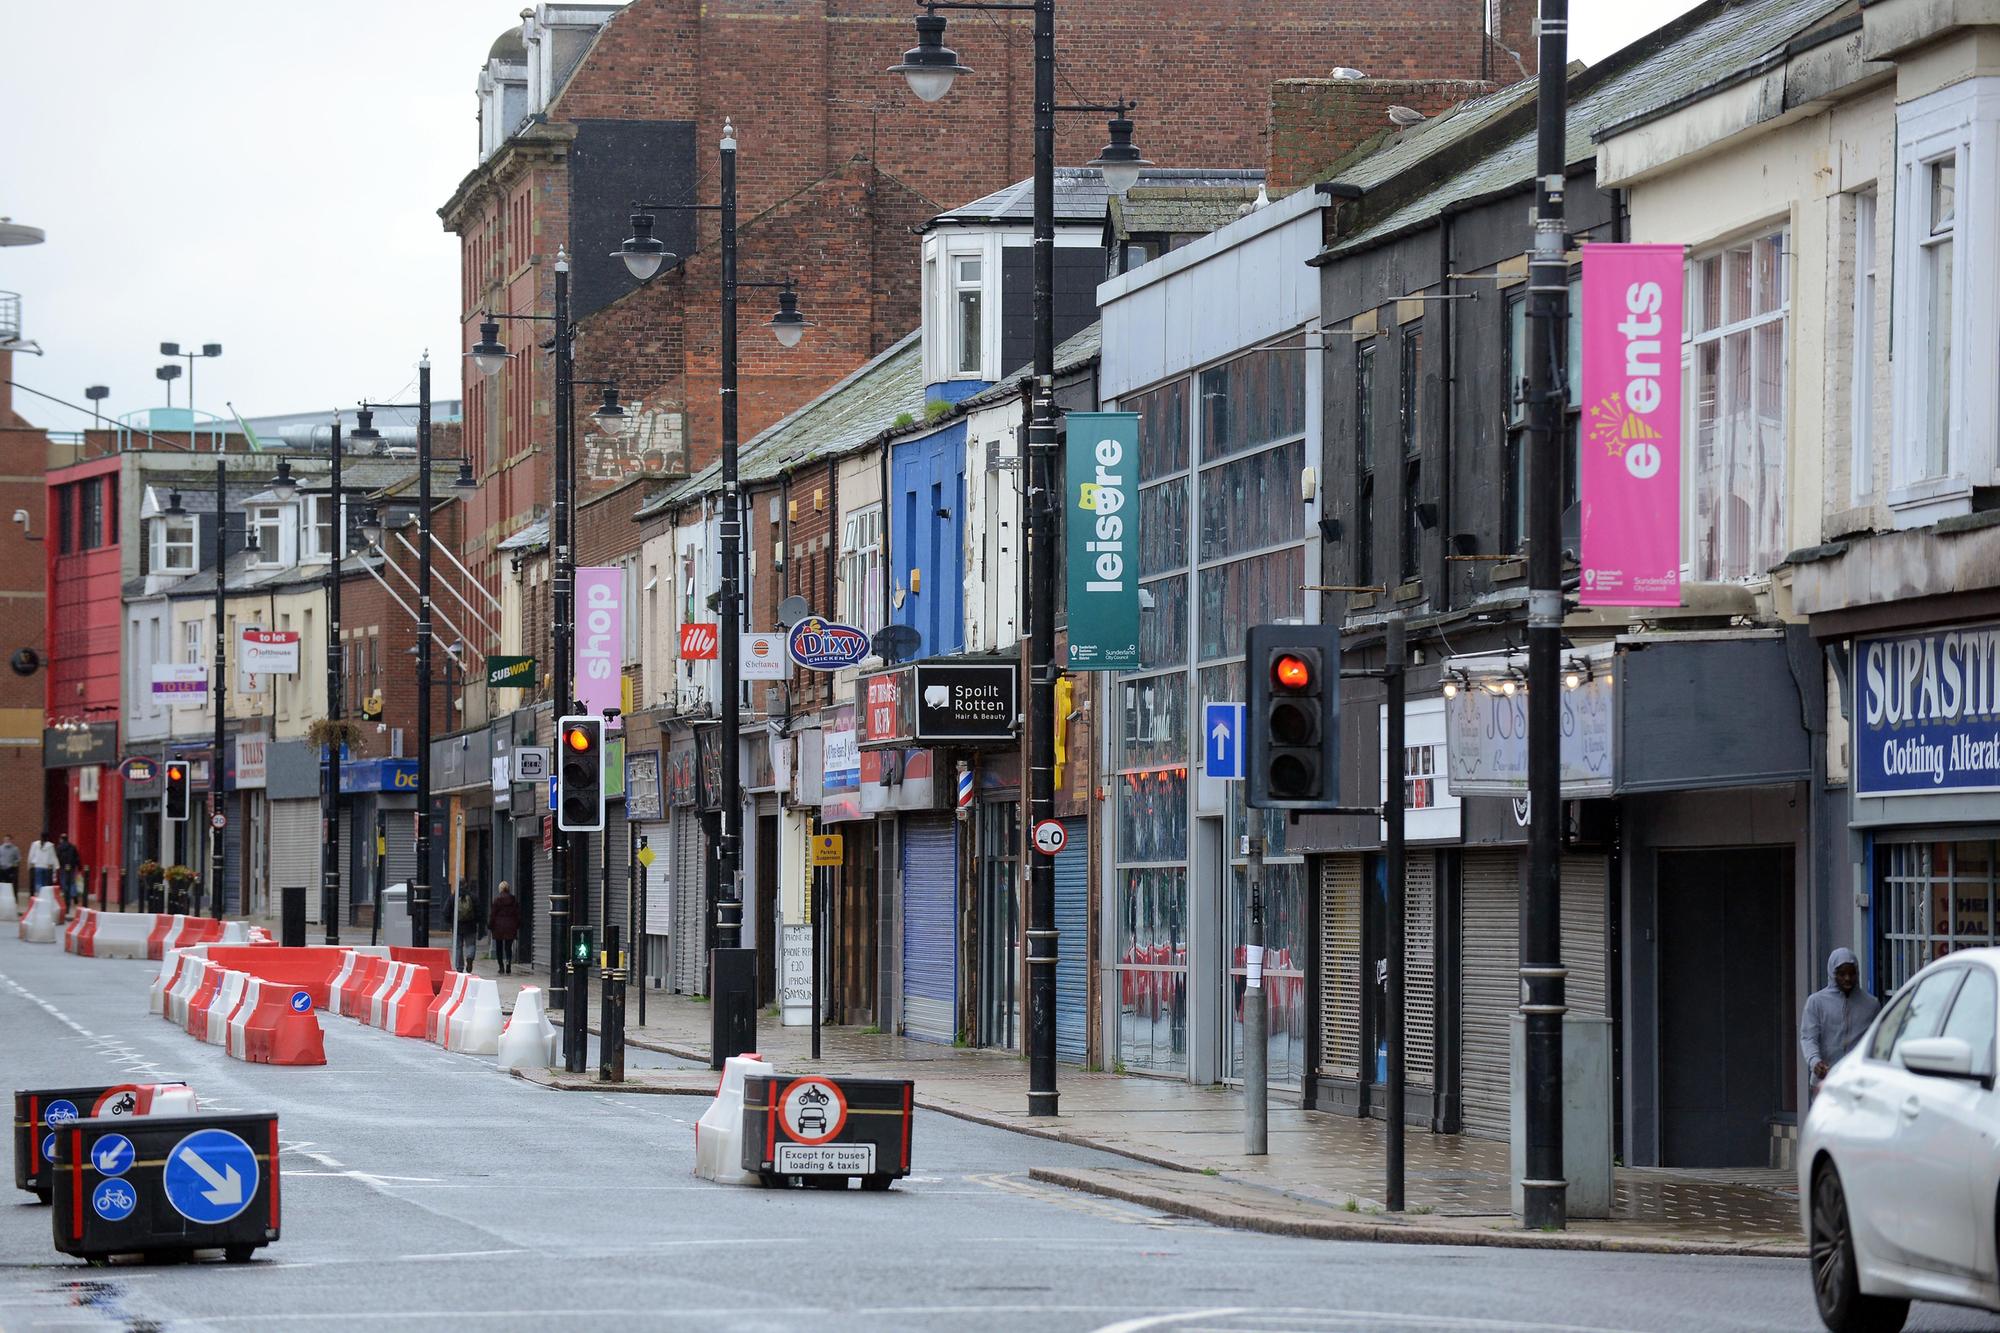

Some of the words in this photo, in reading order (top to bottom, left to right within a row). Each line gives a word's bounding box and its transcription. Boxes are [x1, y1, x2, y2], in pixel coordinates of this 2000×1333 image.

[259, 633, 270, 642] to
[272, 633, 286, 642] let
[580, 584, 618, 680] shop
[683, 628, 715, 656] illy
[802, 629, 864, 660] Dixy
[490, 659, 533, 683] SUBWAY
[162, 682, 176, 692] TO
[178, 681, 197, 692] LET
[955, 685, 999, 699] Spoilt
[955, 700, 1004, 711] Rotten
[981, 713, 1006, 721] Beauty
[1883, 734, 1944, 784] Clothing
[1038, 830, 1062, 845] 20
[785, 1151, 818, 1160] Except
[821, 1151, 834, 1159] for
[838, 1151, 865, 1159] buses
[790, 1161, 825, 1170] loading
[828, 1161, 834, 1169] &
[837, 1161, 860, 1169] taxis
